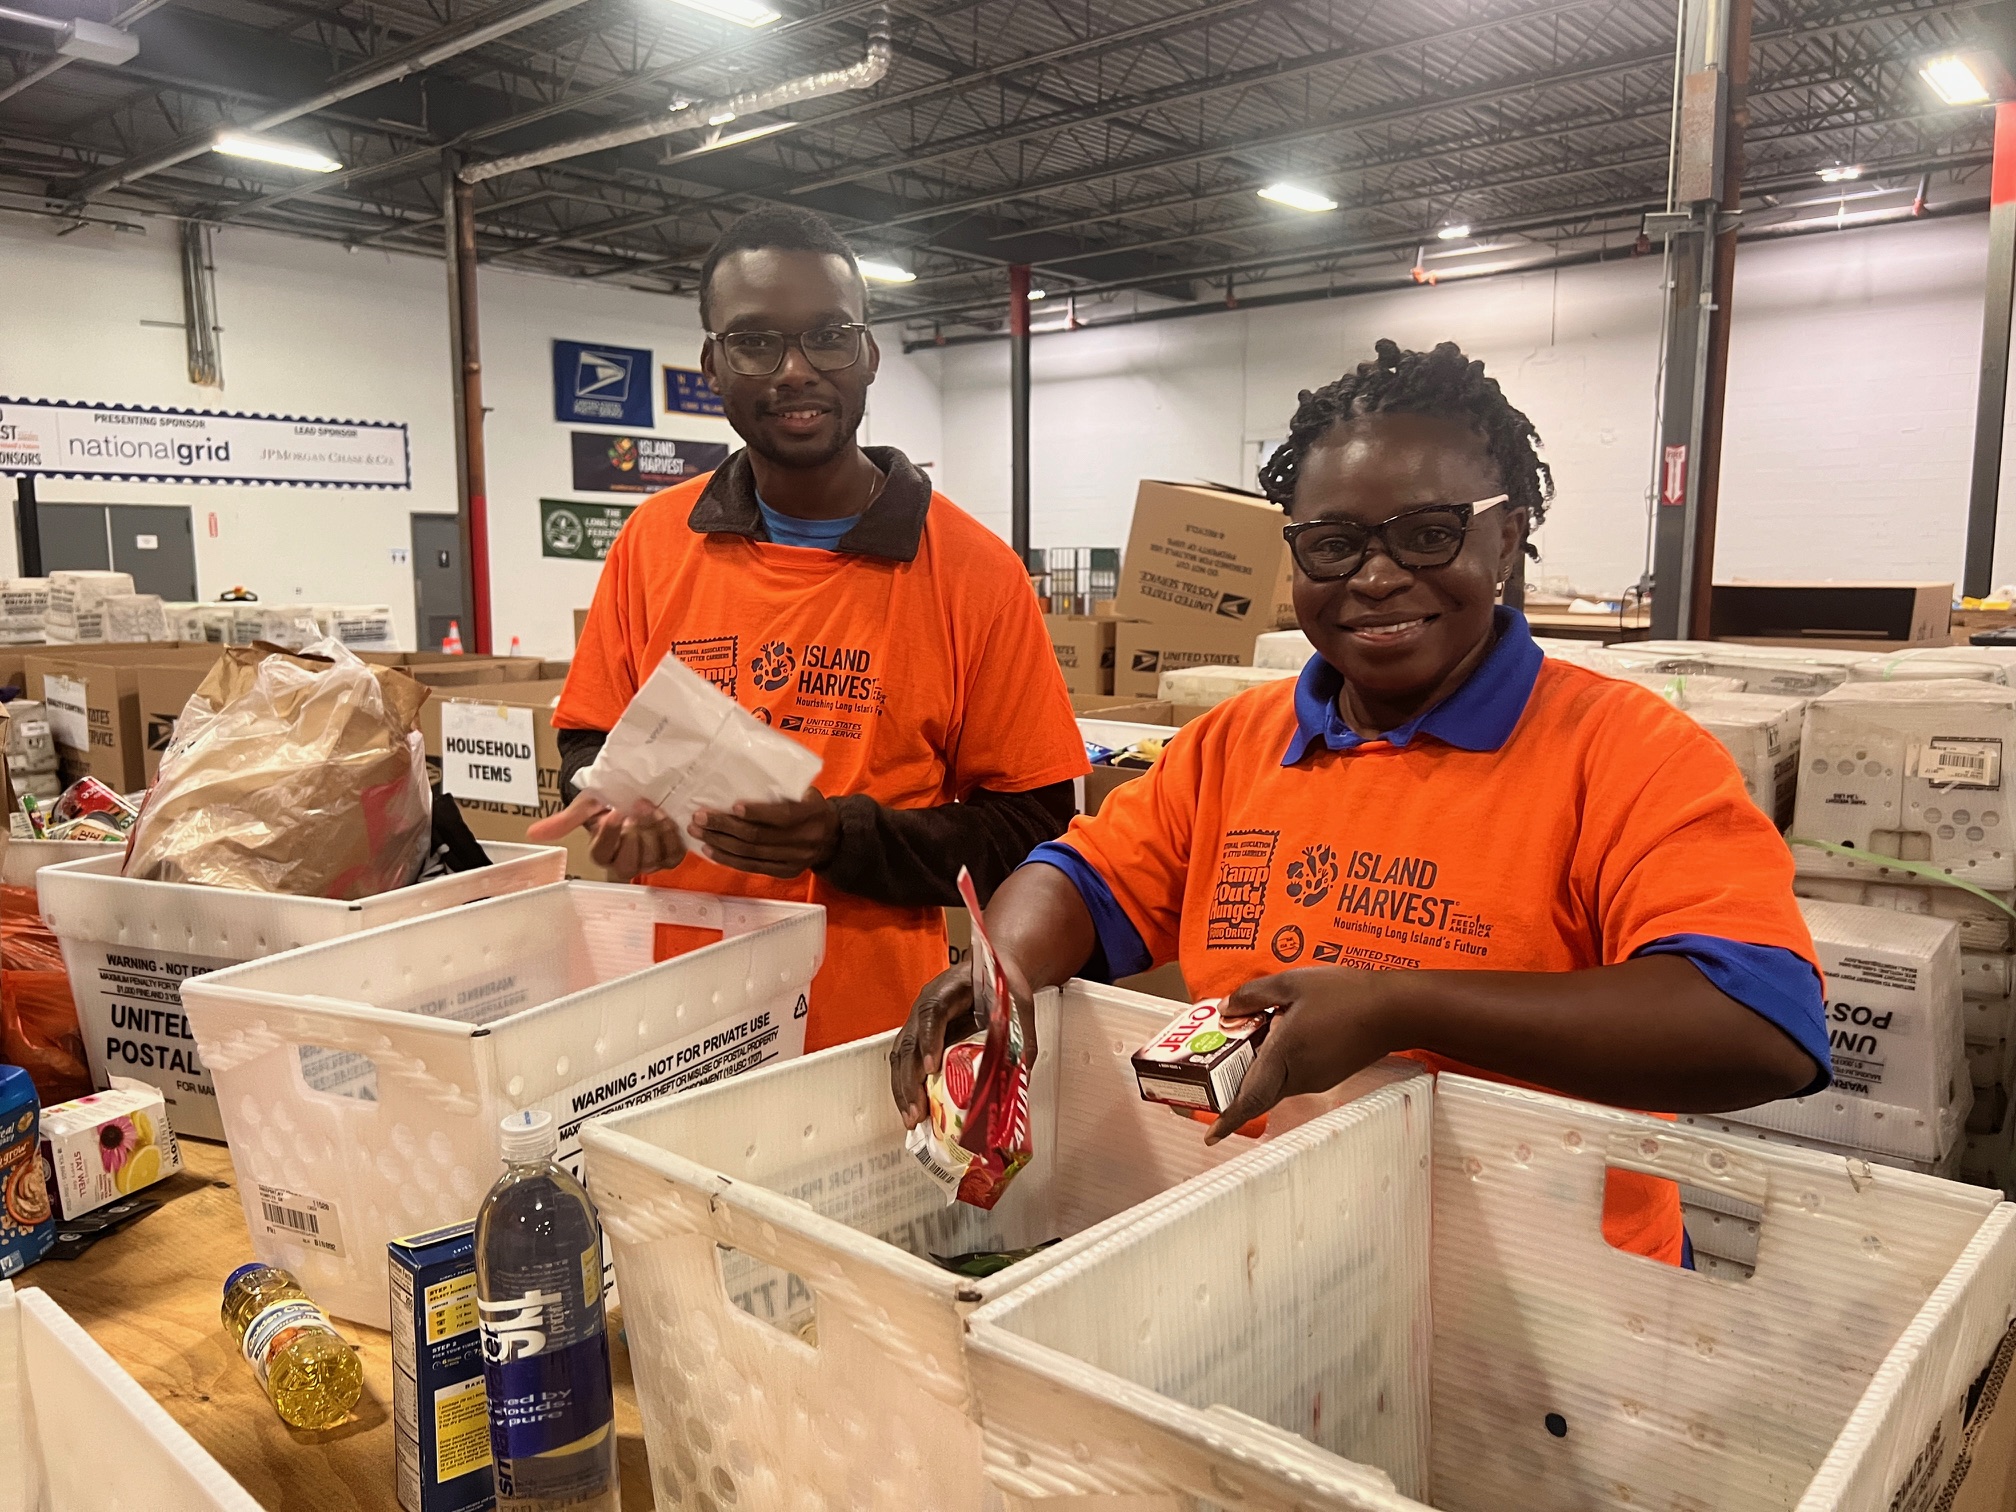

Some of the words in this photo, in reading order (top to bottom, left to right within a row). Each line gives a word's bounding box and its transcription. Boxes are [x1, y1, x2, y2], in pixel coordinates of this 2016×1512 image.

[94, 413, 157, 427] PRESENTING
[159, 417, 206, 429] SPONSOR
[294, 426, 316, 437] LEAD
[317, 427, 358, 438] SPONSOR
[69, 435, 230, 466] nationalgrid
[638, 440, 676, 458] ISLAND
[638, 458, 685, 475] HARVEST
[1139, 571, 1178, 591] SERVICE
[1140, 586, 1174, 602] STATES
[1177, 582, 1219, 599] POSTAL
[1176, 594, 1213, 613] UNITED
[801, 645, 870, 674] ISLAND
[1163, 651, 1200, 663] UNITED
[1203, 653, 1240, 664] STATES
[693, 666, 737, 684] amp
[795, 696, 833, 712] Nourishing
[835, 701, 853, 713] Long
[802, 726, 830, 736] POSTAL
[831, 729, 862, 740] SERVICE
[806, 717, 835, 728] UNITED
[835, 720, 862, 731] STATES
[446, 737, 531, 760] HOUSEHOLD
[468, 764, 512, 783] ITEMS
[1347, 851, 1438, 890] ISLAND
[1209, 901, 1265, 924] Hunger
[1336, 883, 1454, 931] HARVEST
[1225, 927, 1252, 940] DRIVE
[1333, 917, 1382, 938] Nourishing
[1385, 927, 1408, 943] Long
[1410, 931, 1451, 950] Island's
[1453, 941, 1488, 957] Future
[1448, 926, 1491, 939] AMERICA
[106, 954, 157, 972] WARNING
[166, 964, 189, 977] NOT
[1340, 957, 1377, 970] POSTAL
[1345, 946, 1382, 961] UNITED
[1383, 952, 1420, 968] STATES
[100, 972, 129, 984] MAXIMUM
[130, 975, 157, 988] PENALTY
[157, 979, 171, 991] FOR
[151, 990, 164, 1000] AND
[111, 1003, 194, 1040] UNITED
[1824, 1001, 1893, 1030] POS
[1830, 1029, 1877, 1055] UNI
[106, 1037, 201, 1075] POSTAL
[571, 1072, 637, 1113] WARNING
[648, 1055, 674, 1080] NOT
[676, 1043, 701, 1067] FOR
[703, 1022, 748, 1054] PRIVATE
[750, 1012, 770, 1034] USE
[636, 1091, 652, 1105] FOR
[652, 1078, 675, 1099] THEFT
[675, 1075, 687, 1088] OR
[687, 1063, 713, 1085] MISUSE
[713, 1058, 723, 1070] OF
[723, 1047, 749, 1068] POSTAL
[748, 1030, 779, 1055] PROPERTY
[733, 1061, 747, 1075] USC
[176, 1080, 197, 1092] FOR
[198, 1083, 216, 1096] MAI
[1830, 1079, 1869, 1095] WARN
[73, 1151, 83, 1173] STAY
[77, 1173, 87, 1198] WELL
[430, 1285, 447, 1297] STEP
[432, 1343, 451, 1354] STEP
[541, 1388, 572, 1402] by
[508, 1410, 563, 1428] pure
